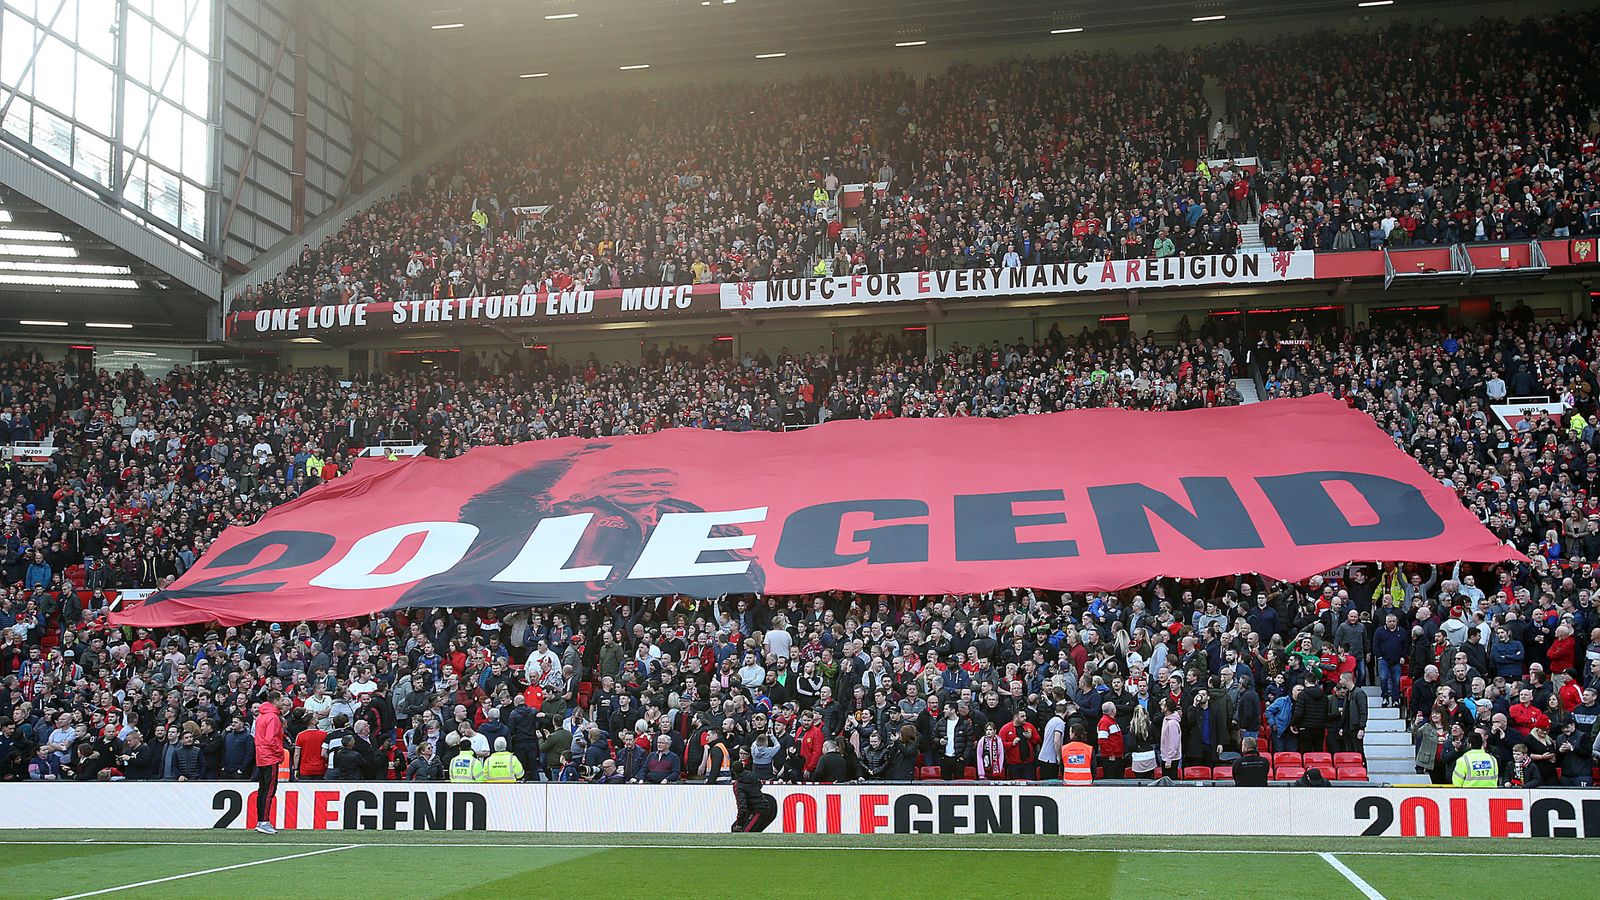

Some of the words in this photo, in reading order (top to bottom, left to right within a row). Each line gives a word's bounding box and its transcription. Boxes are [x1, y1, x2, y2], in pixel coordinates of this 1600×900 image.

[1126, 253, 1259, 283] RELIGION
[255, 308, 300, 332] ONE
[307, 303, 368, 328] LOVE
[392, 294, 537, 324] STRETFORD
[546, 291, 595, 315] END
[621, 285, 692, 311] MUFC
